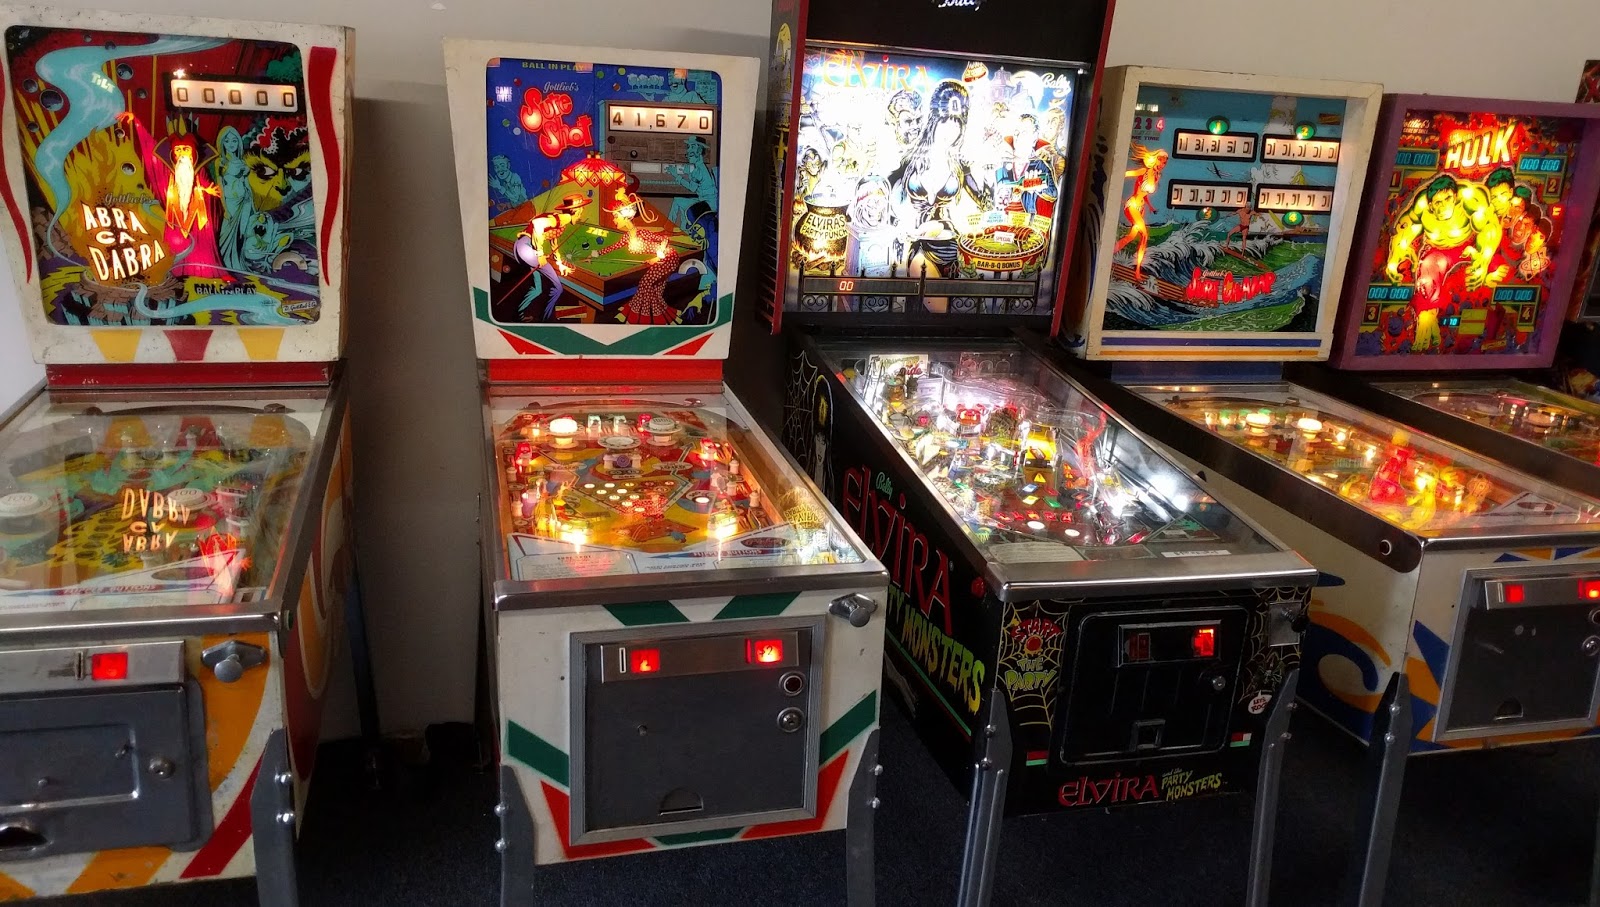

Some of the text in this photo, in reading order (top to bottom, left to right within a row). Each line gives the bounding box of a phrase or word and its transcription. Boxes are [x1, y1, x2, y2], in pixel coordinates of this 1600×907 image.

[521, 61, 546, 70] BALL
[548, 63, 558, 71] IN
[823, 53, 930, 91] ELVIRA
[91, 72, 114, 94] TILT
[495, 86, 513, 95] GAME
[543, 81, 580, 94] Gottlieb's
[1040, 72, 1071, 98] Bally
[496, 94, 513, 103] OVER
[520, 87, 573, 132] Sure
[539, 114, 594, 158] Shot
[1445, 122, 1517, 169] HULK
[81, 203, 149, 234] ABRA
[95, 230, 136, 245] CA
[88, 239, 166, 281] DABRA
[1001, 260, 1022, 269] BONUS
[196, 286, 221, 296] BALL
[234, 286, 258, 296] PLAY
[839, 280, 854, 291] 00
[876, 471, 894, 499] Bally
[901, 603, 985, 715] MONSTERS
[1016, 657, 1044, 672] THE
[1004, 669, 1058, 691] PARTY
[1057, 771, 1160, 807] ELVIRA
[1162, 769, 1194, 790] PARTY
[1166, 772, 1223, 801] MONSTERS
